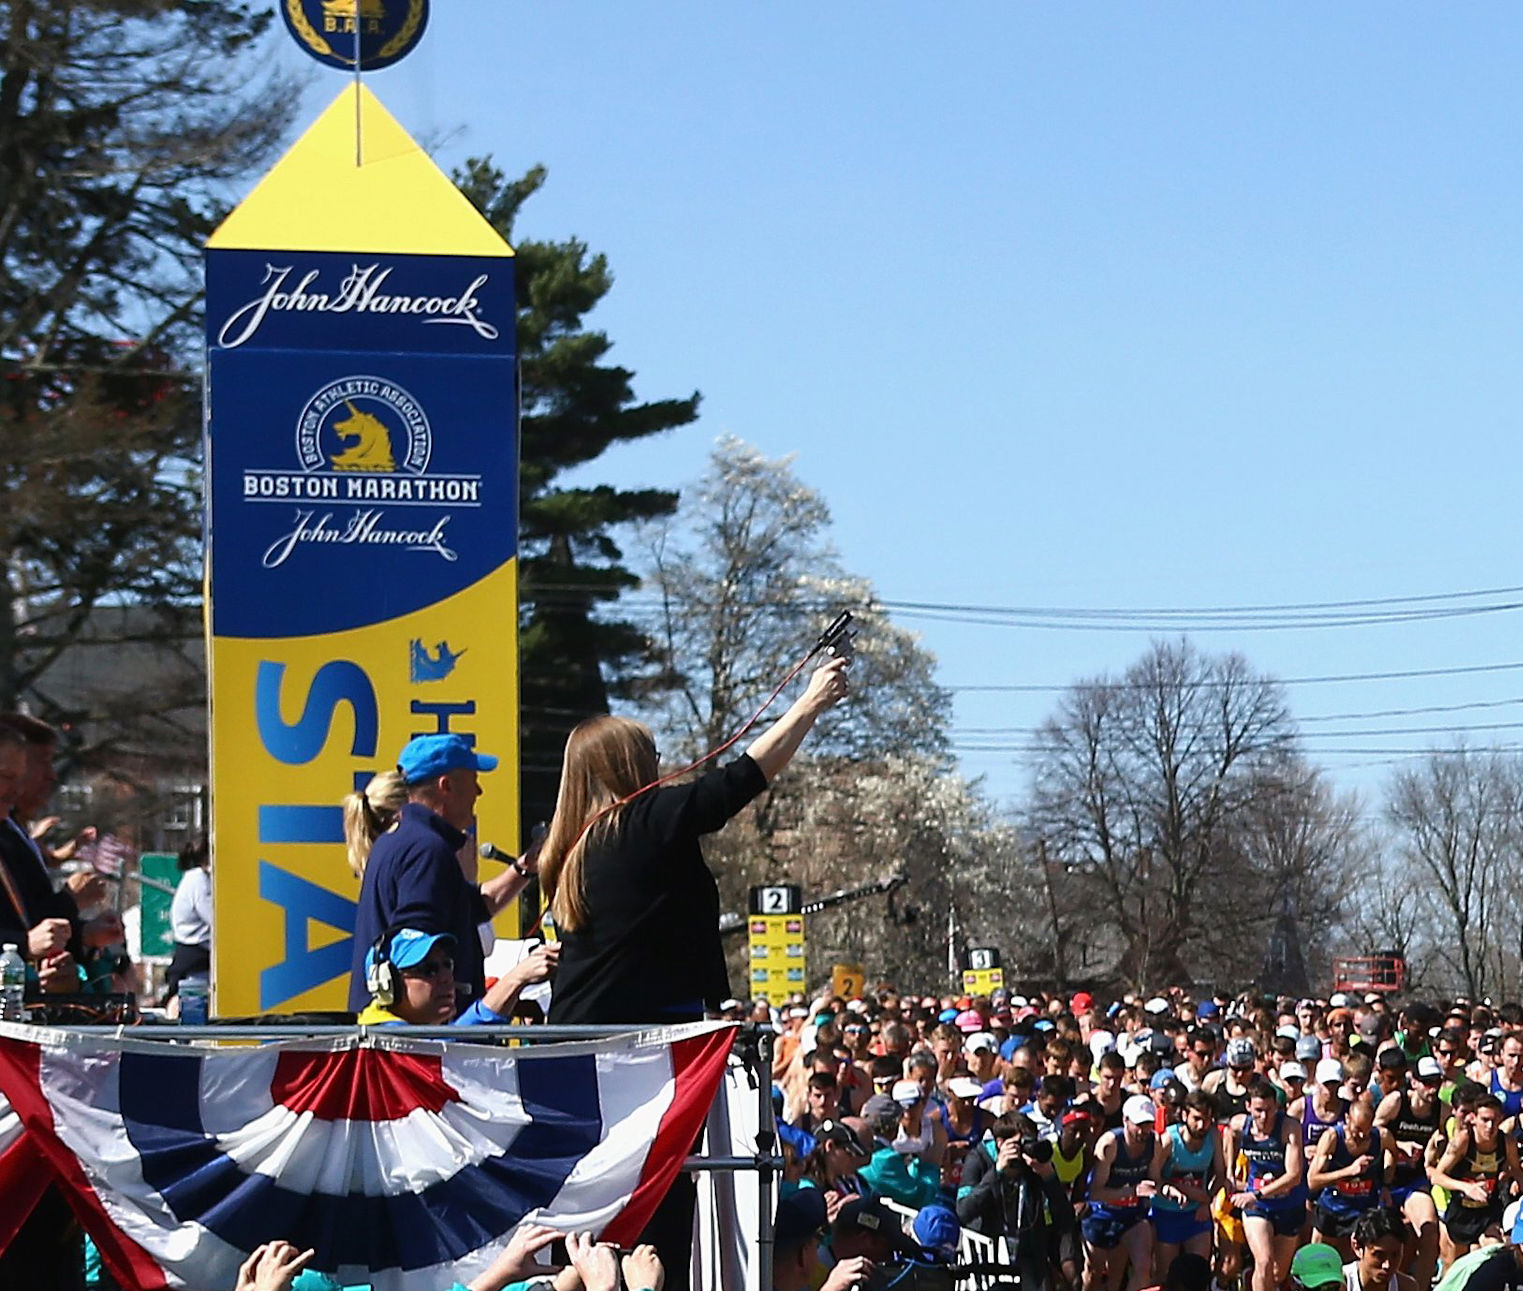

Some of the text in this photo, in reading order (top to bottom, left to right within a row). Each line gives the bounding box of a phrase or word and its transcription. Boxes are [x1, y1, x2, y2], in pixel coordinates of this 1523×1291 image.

[218, 262, 499, 349] John Hancock
[304, 381, 426, 466] BOSTON ATHLETIC ASSOCIATION
[243, 476, 479, 501] BOSTON MARATHON
[263, 509, 459, 568] John Hancock
[254, 659, 379, 1012] STA
[767, 890, 783, 911] 2
[842, 978, 855, 998] 2
